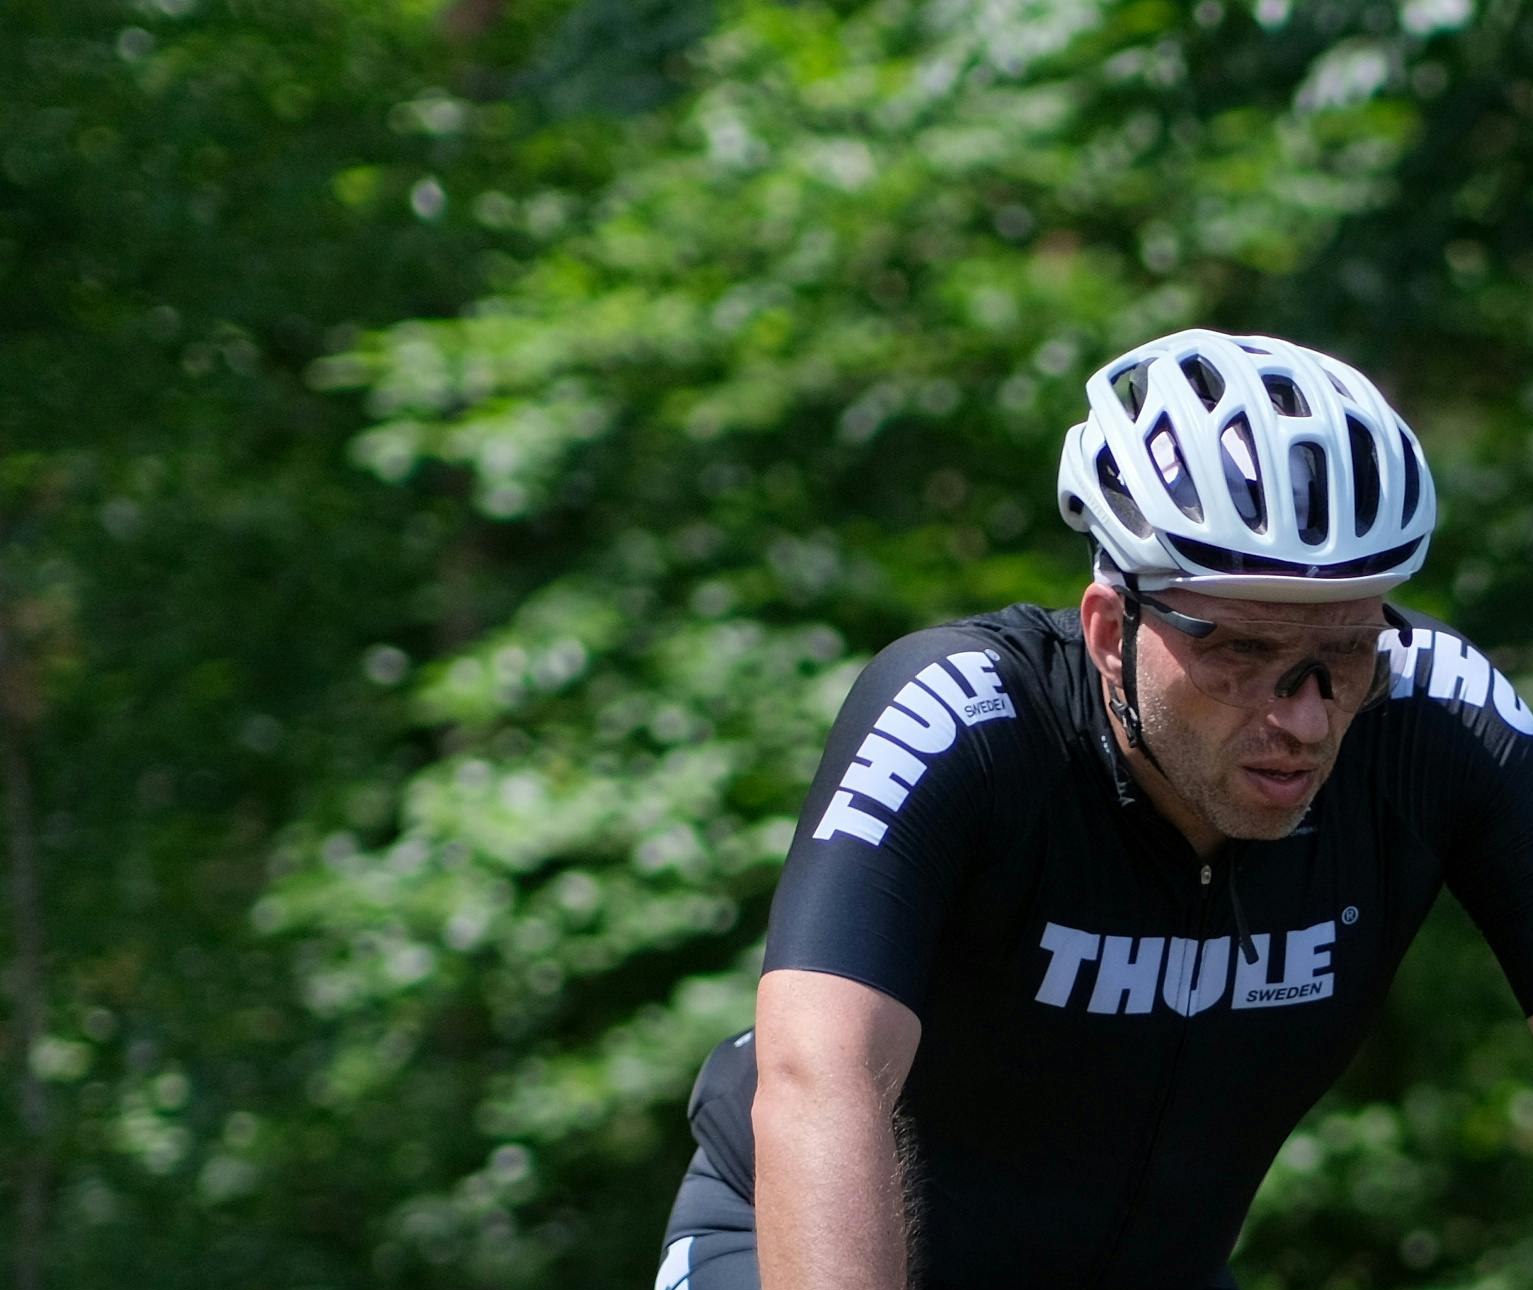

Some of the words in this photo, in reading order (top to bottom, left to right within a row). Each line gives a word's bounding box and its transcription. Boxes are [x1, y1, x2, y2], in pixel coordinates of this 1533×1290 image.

[812, 650, 1017, 846] THULE
[1034, 920, 1337, 1017] THULE
[1245, 981, 1323, 1004] SWEDEN
